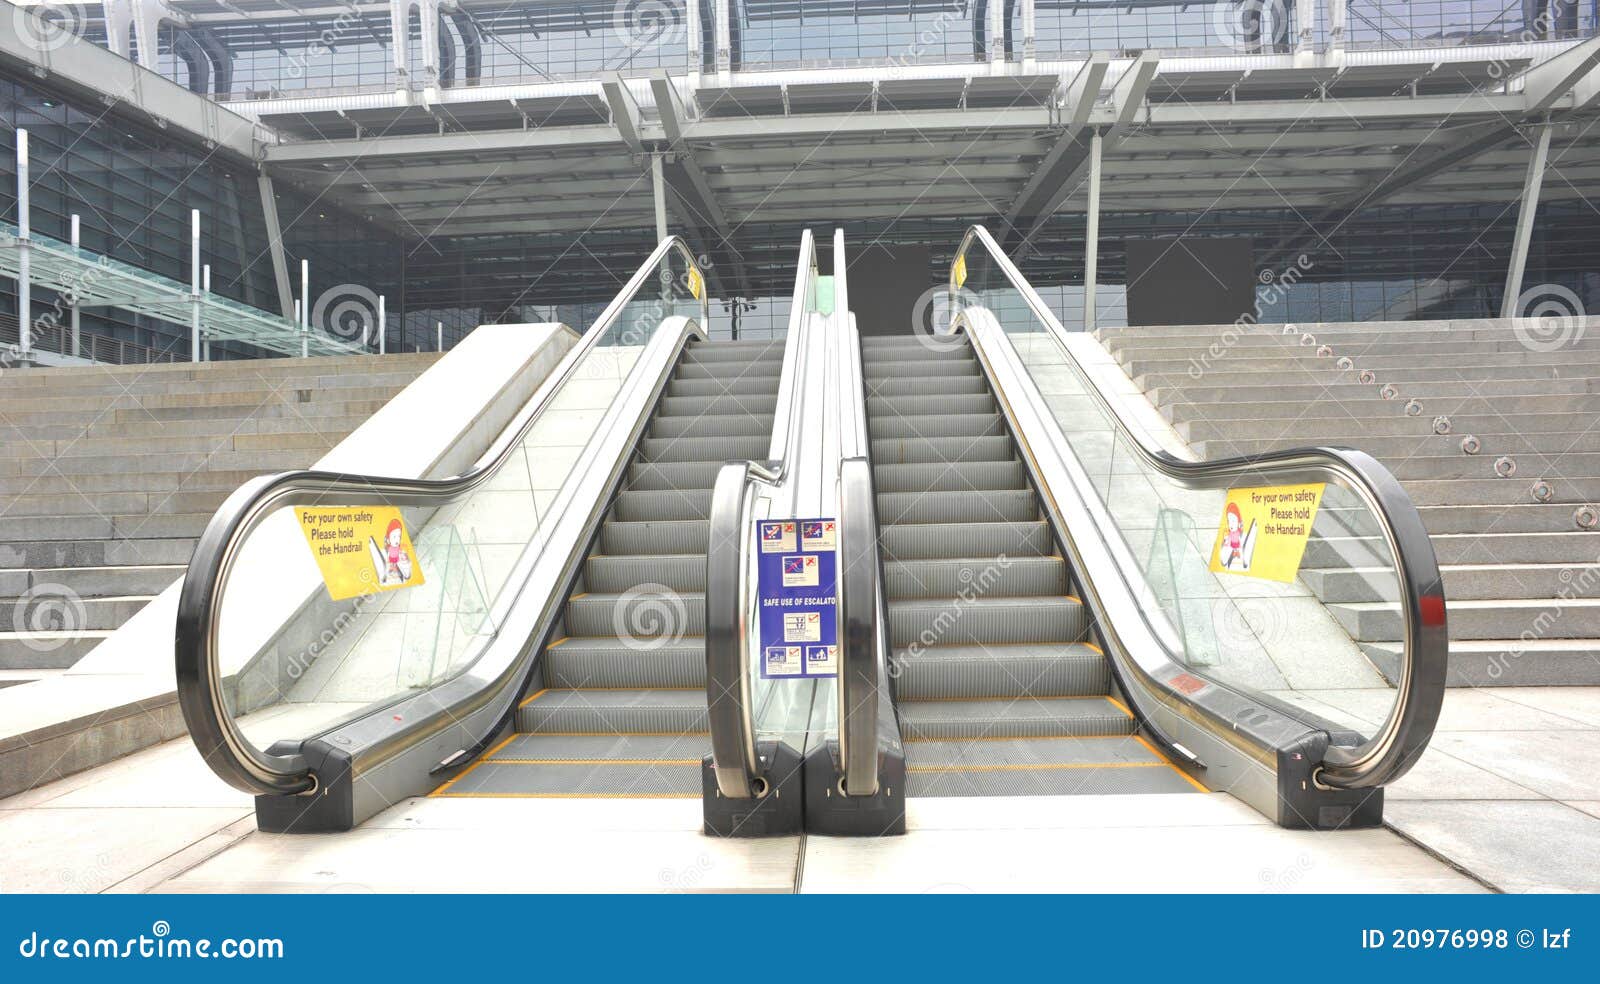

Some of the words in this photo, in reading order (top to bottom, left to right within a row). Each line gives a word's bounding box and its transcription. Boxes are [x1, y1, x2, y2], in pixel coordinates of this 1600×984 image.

[1251, 492, 1263, 503] For
[1263, 493, 1278, 506] your
[1279, 493, 1293, 502] own
[1295, 489, 1316, 504] safety
[303, 511, 317, 524] For
[318, 513, 335, 526] your
[337, 513, 352, 522] own
[353, 511, 373, 524] safety
[1271, 507, 1293, 520] Please
[1294, 507, 1310, 519] hold
[311, 528, 337, 540] Please
[338, 527, 354, 538] hold
[1264, 523, 1275, 535] the
[1276, 523, 1305, 536] Handrail
[319, 543, 332, 555] the
[333, 541, 363, 554] Handrail
[763, 598, 780, 607] SAFE
[780, 598, 793, 606] USE
[794, 597, 803, 606] OF
